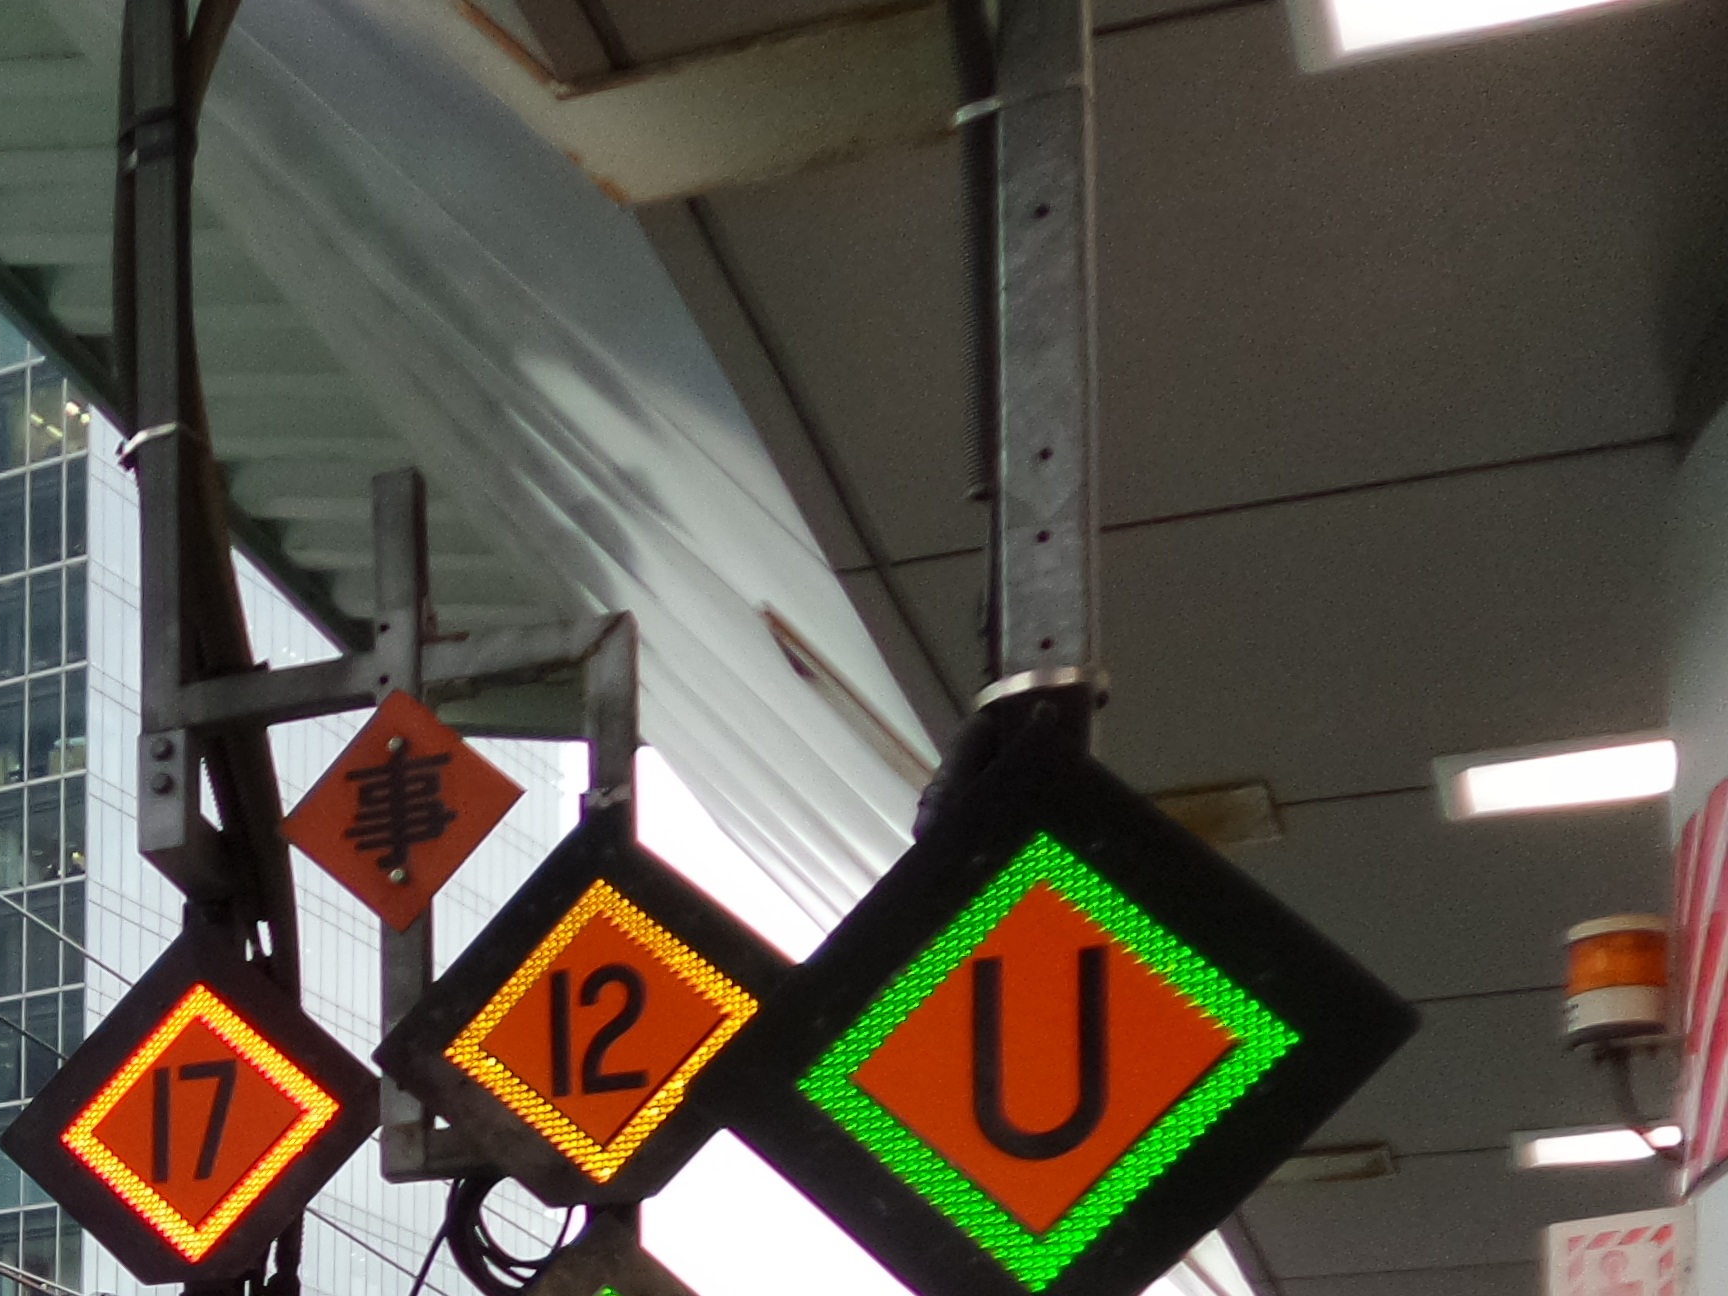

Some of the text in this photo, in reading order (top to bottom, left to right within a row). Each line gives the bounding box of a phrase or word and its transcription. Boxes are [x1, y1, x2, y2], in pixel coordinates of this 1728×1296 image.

[345, 745, 458, 866] 事
[549, 962, 648, 1098] 12
[971, 946, 1109, 1161] U
[152, 1059, 238, 1185] 17
